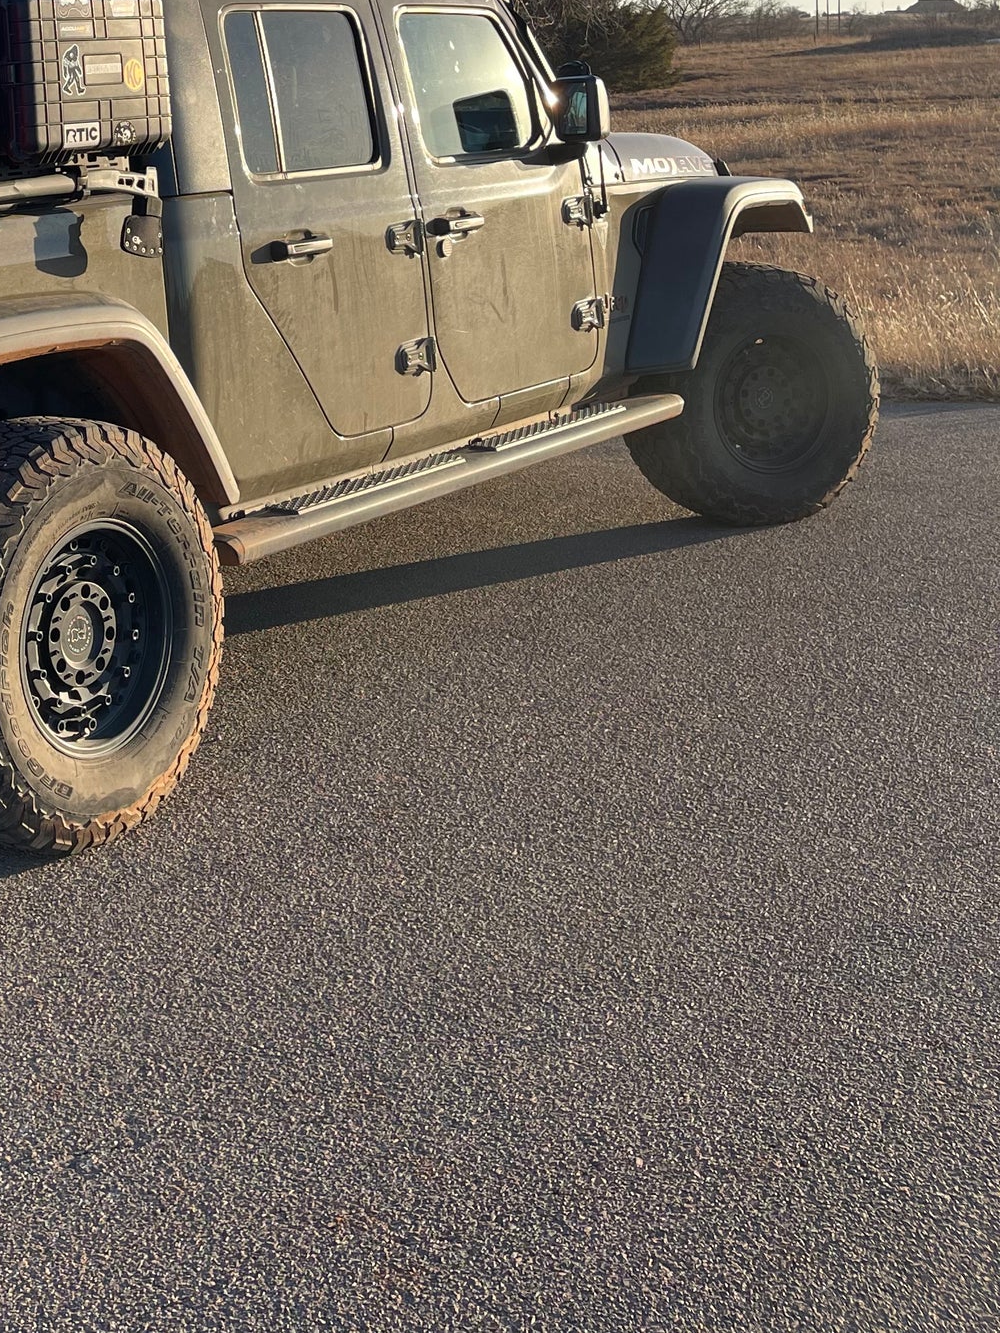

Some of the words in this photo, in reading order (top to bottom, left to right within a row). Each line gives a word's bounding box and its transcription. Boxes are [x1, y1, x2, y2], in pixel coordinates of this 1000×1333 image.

[125, 61, 142, 88] KC
[65, 127, 98, 143] RTIC
[629, 155, 715, 175] MOJAVE
